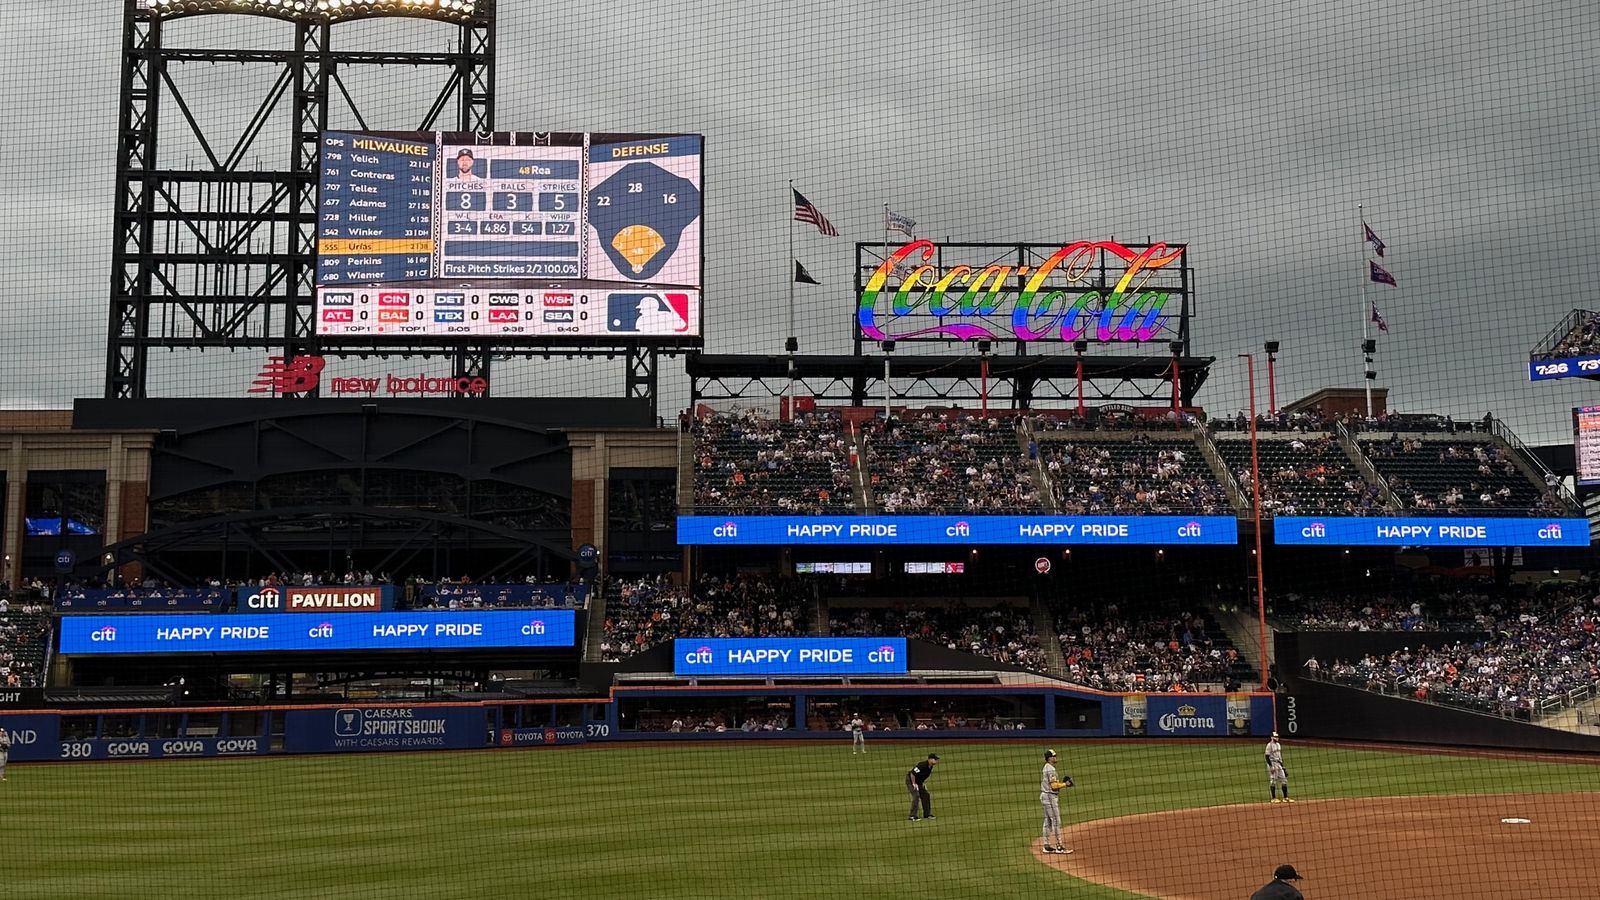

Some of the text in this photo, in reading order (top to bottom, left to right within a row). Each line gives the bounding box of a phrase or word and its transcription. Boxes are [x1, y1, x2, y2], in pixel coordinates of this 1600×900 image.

[326, 138, 344, 147] OPS
[352, 139, 428, 156] MILWAUKEE
[612, 143, 669, 158] DEFENSE
[351, 154, 379, 164] Yelich
[350, 170, 395, 180] Contreras
[518, 165, 550, 175] 48 Rea
[349, 184, 378, 193] Tellez
[628, 183, 643, 193] 28
[349, 199, 387, 208] Adames
[460, 193, 472, 209] 8
[506, 194, 516, 209] 3
[554, 194, 565, 210] 5
[597, 196, 610, 206] 22
[663, 194, 677, 204] 16
[348, 228, 383, 236] Winker
[454, 223, 472, 233] 3-4
[484, 223, 507, 233] 4.86
[521, 223, 534, 233] 54
[552, 223, 570, 233] 1.27
[348, 257, 382, 265] Perkins
[445, 264, 578, 274] First Pitch Strikes 2/2 100.0%
[347, 271, 384, 279] Wiemer
[858, 240, 1184, 341] Coca-Cola
[326, 294, 369, 303] MIN 0
[383, 295, 424, 304] CIN 0
[436, 295, 479, 304] DET 0
[489, 295, 533, 304] CWS 0
[545, 295, 588, 304] WSH 0
[325, 311, 368, 320] ATL 0
[380, 311, 424, 320] BAL 0
[436, 311, 479, 320] TEX 0
[490, 311, 533, 320] LAA 0
[545, 311, 588, 320] SEA 0
[1535, 363, 1569, 375] 7:26
[331, 373, 487, 393] new balance
[713, 521, 1201, 537] citi HAPPY PRIDE citi HAPPY PRIDE citi
[1302, 522, 1562, 539] citi HAPPY PRIDE citi
[57, 555, 70, 563] citi
[580, 550, 593, 558] citi
[248, 589, 376, 608] citi PAVILION
[91, 620, 545, 641] citi HAPPY PRIDE citi HAPPY PRIDE citi
[686, 646, 895, 663] citi HAPPY PRIDE citi
[365, 709, 413, 718] CAESARS
[1288, 696, 1297, 733] 330
[364, 720, 446, 735] SPORTSBOOK
[1159, 713, 1215, 732] Corona
[556, 731, 584, 739] TOYOTA
[586, 724, 609, 736] 370
[514, 733, 543, 741] TOYOTA
[163, 742, 203, 753] GOYA
[217, 740, 257, 752] GOYA
[335, 739, 357, 747] WITH
[361, 738, 399, 746] CAESARS
[61, 743, 91, 758] 380
[108, 743, 149, 755] GOYA
